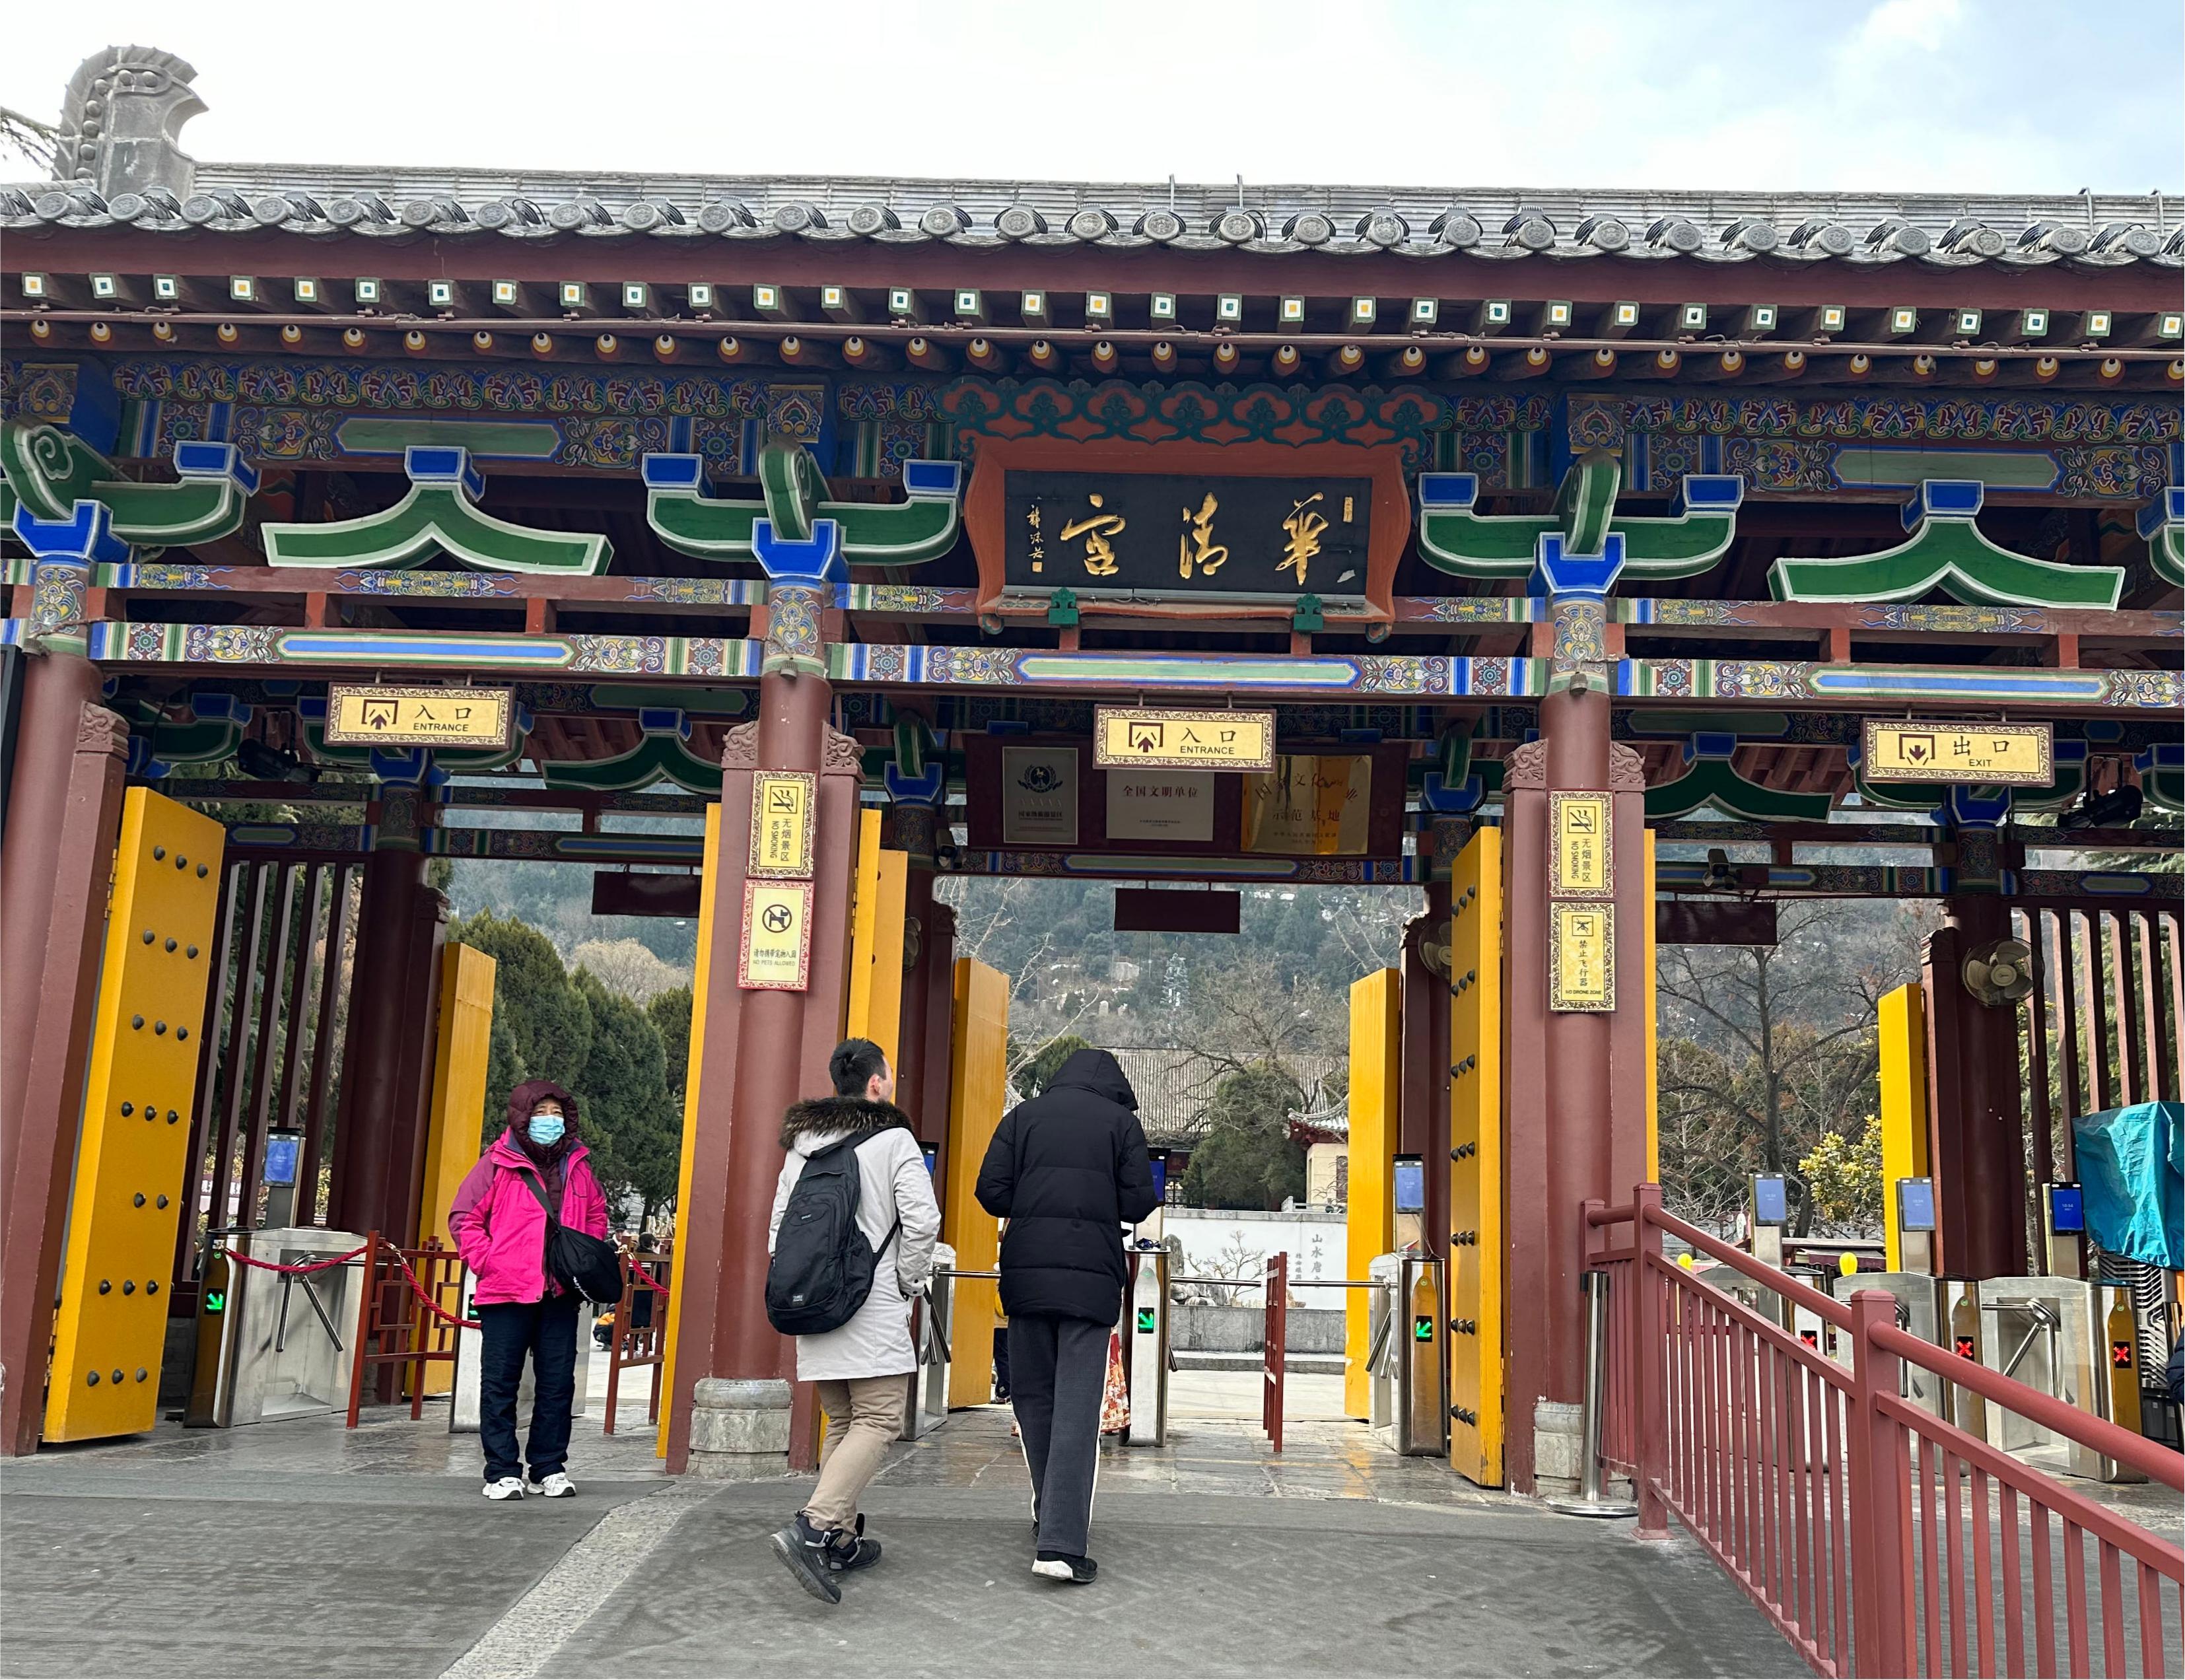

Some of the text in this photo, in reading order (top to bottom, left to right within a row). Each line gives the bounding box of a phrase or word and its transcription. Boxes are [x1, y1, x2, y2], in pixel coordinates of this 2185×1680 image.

[415, 704, 471, 720] 入口
[413, 722, 469, 732] ENTRANCE
[1181, 727, 1236, 743] 入口
[1180, 746, 1235, 754] ENTRANCE
[1953, 736, 2010, 756] 出口
[1969, 759, 1992, 767] EXIT
[1123, 785, 1198, 798] 全国文明单位
[770, 821, 779, 858] NO SMOKING
[780, 818, 792, 862] 无烟景区
[1571, 841, 1579, 850] NO
[1582, 838, 1591, 882] 无烟景区
[1579, 940, 1589, 987] 禁止飞行器
